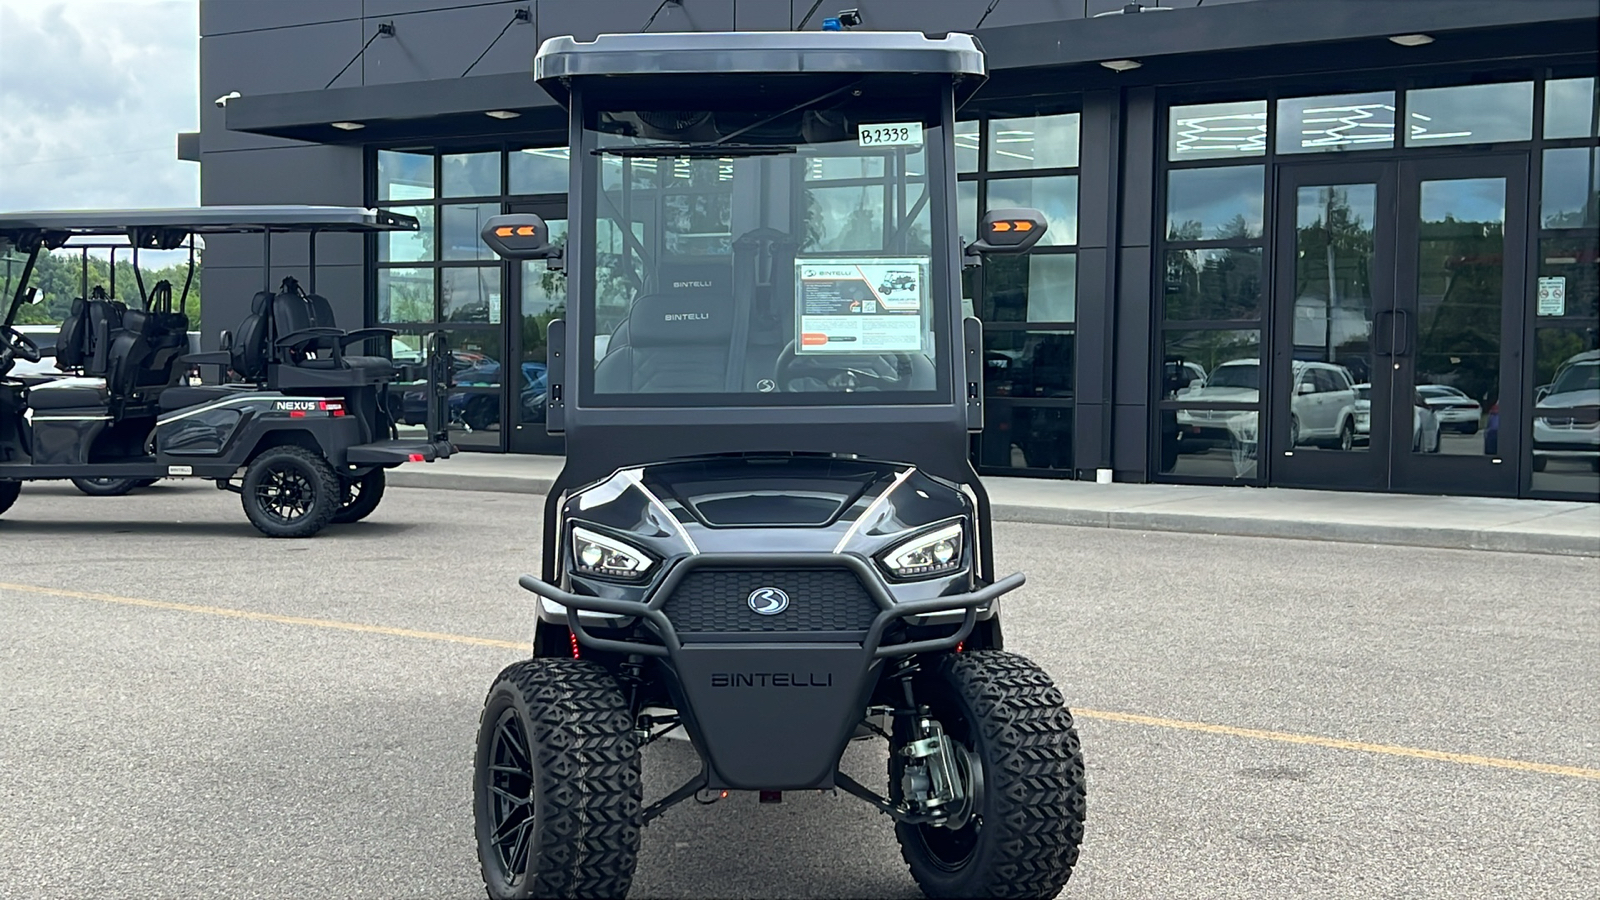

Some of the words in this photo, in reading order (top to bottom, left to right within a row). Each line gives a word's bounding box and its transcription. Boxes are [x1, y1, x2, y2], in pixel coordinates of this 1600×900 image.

[861, 128, 909, 144] B2338
[664, 313, 709, 321] BINTELLI
[276, 401, 315, 410] NEXUS
[711, 672, 832, 687] BINTELLI
